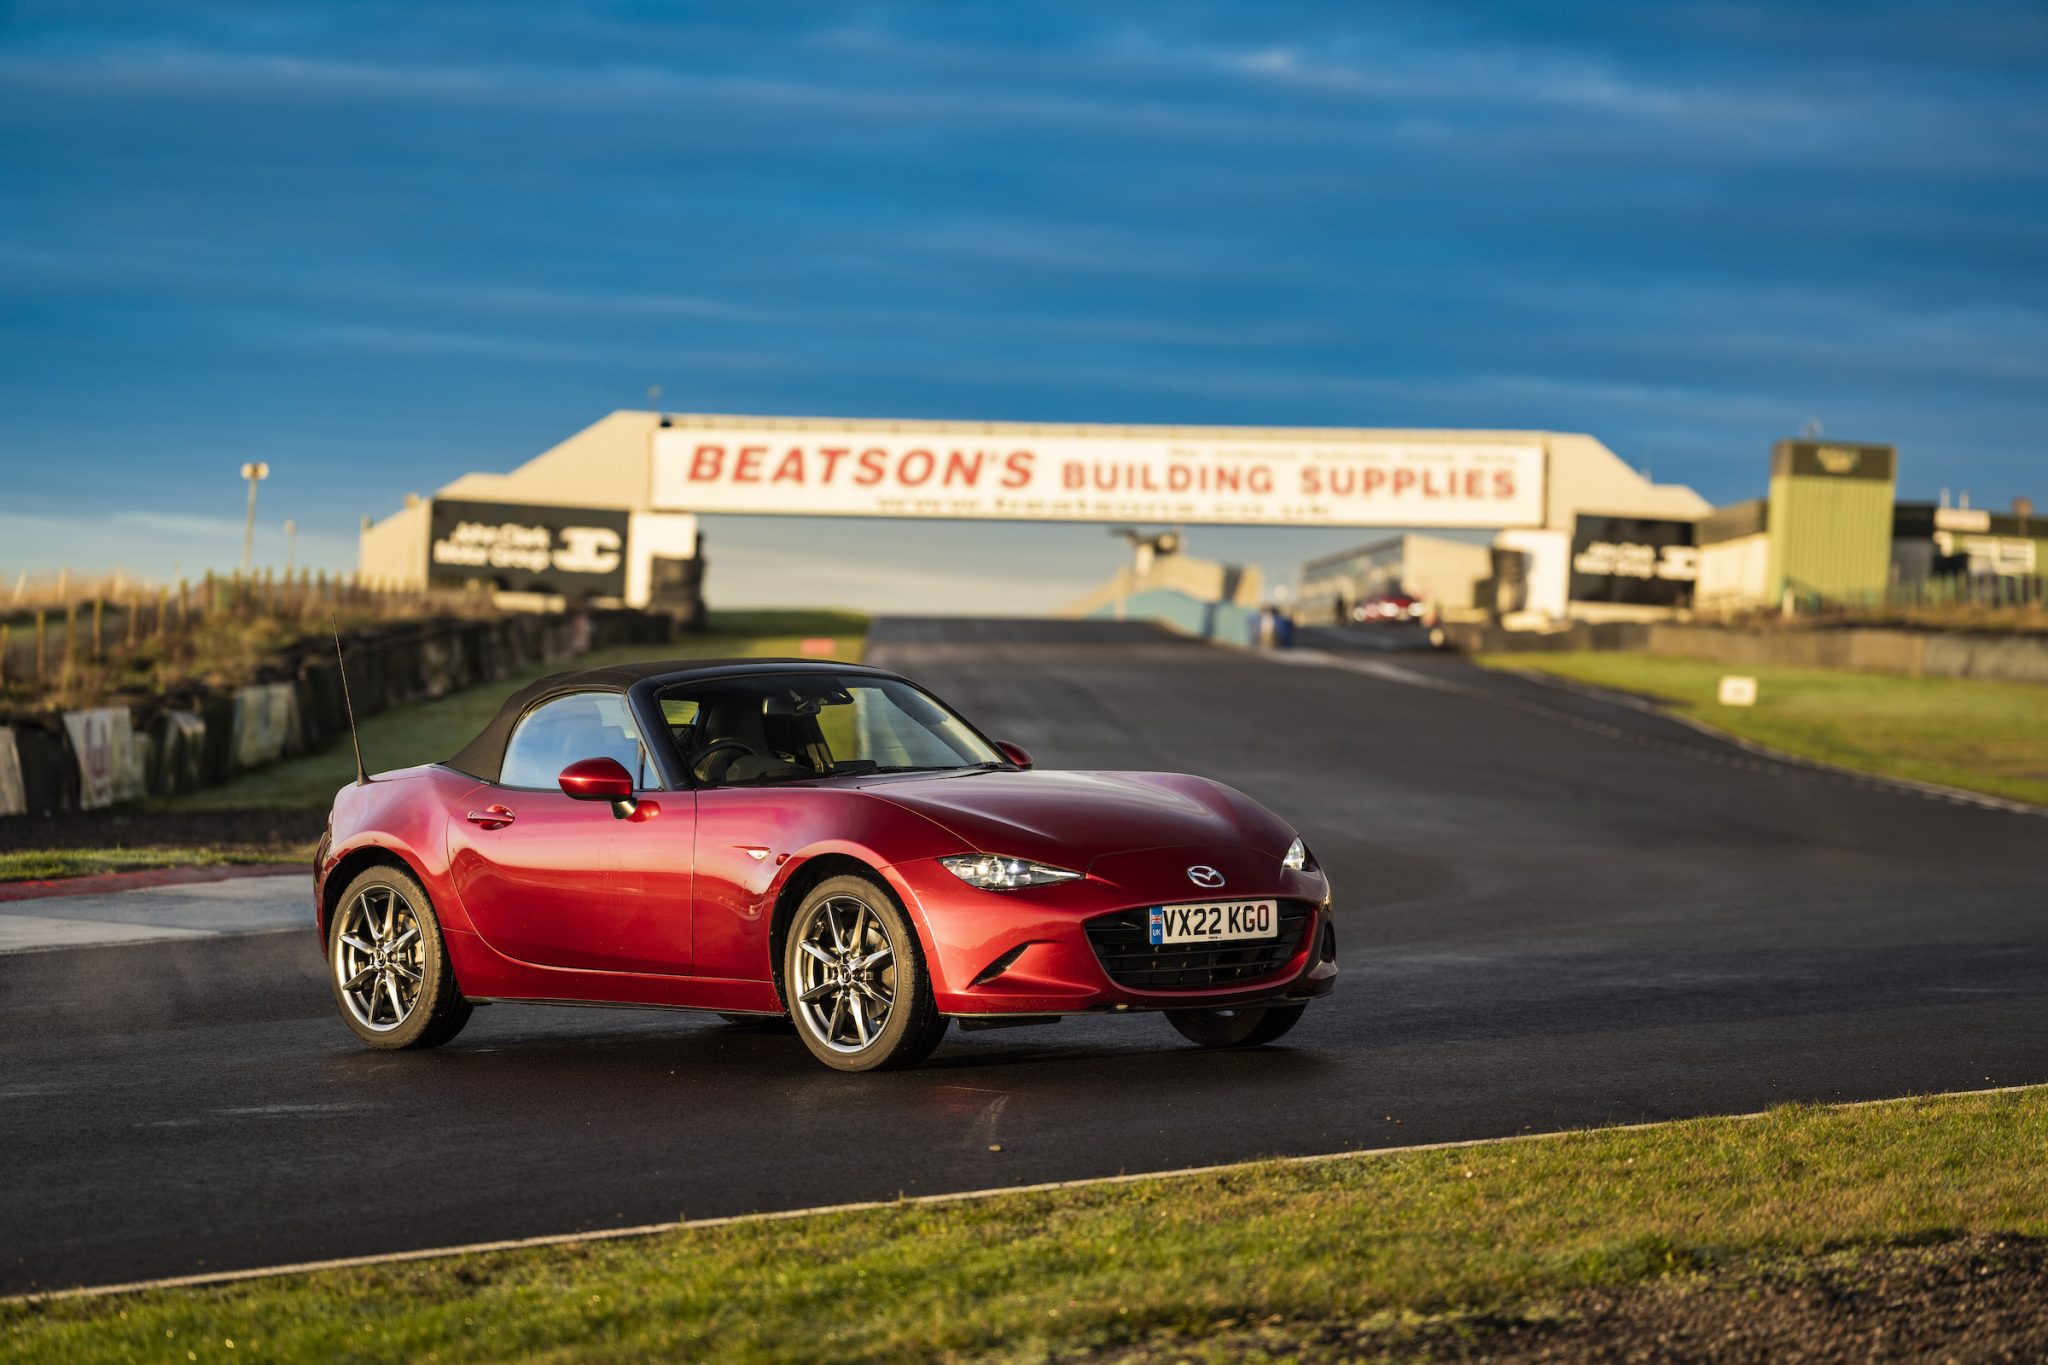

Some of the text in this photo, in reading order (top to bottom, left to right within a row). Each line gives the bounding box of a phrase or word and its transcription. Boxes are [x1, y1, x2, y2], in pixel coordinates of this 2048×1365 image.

[688, 444, 1516, 499] BEATSON'S BUILDING SUPPLIES
[1152, 928, 1161, 937] UK
[1163, 904, 1270, 937] VX22 KGO
